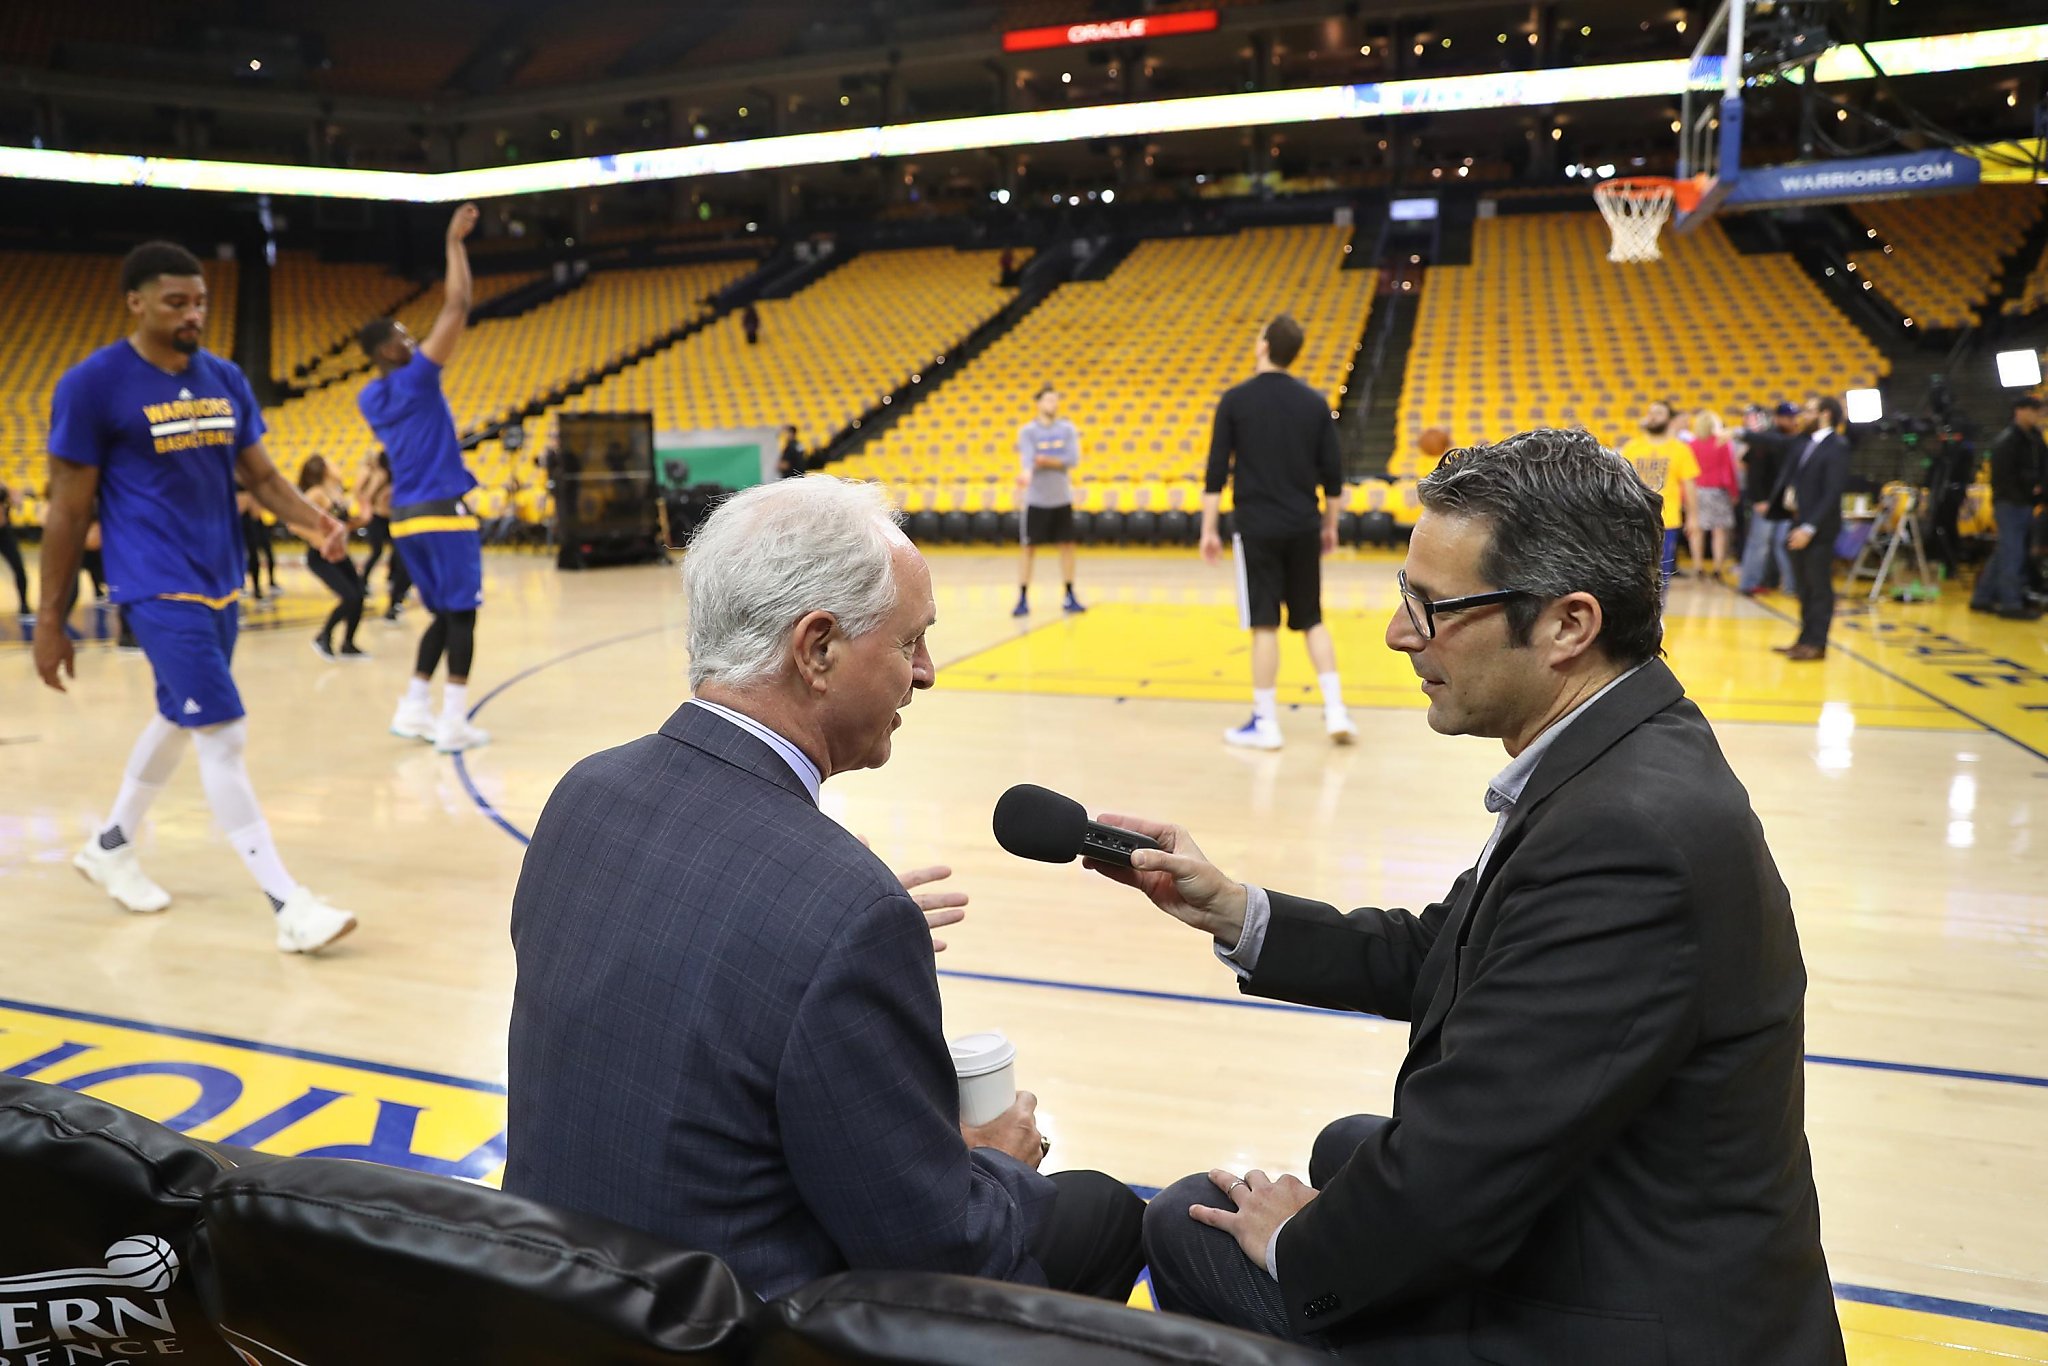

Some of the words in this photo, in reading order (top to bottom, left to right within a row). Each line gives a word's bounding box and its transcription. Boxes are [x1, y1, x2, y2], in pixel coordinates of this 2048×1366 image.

[1067, 18, 1148, 43] ORACLE
[1780, 161, 1954, 192] WARRIORS.COM
[143, 397, 234, 423] WARRIORS
[153, 430, 235, 454] BASKETBALL
